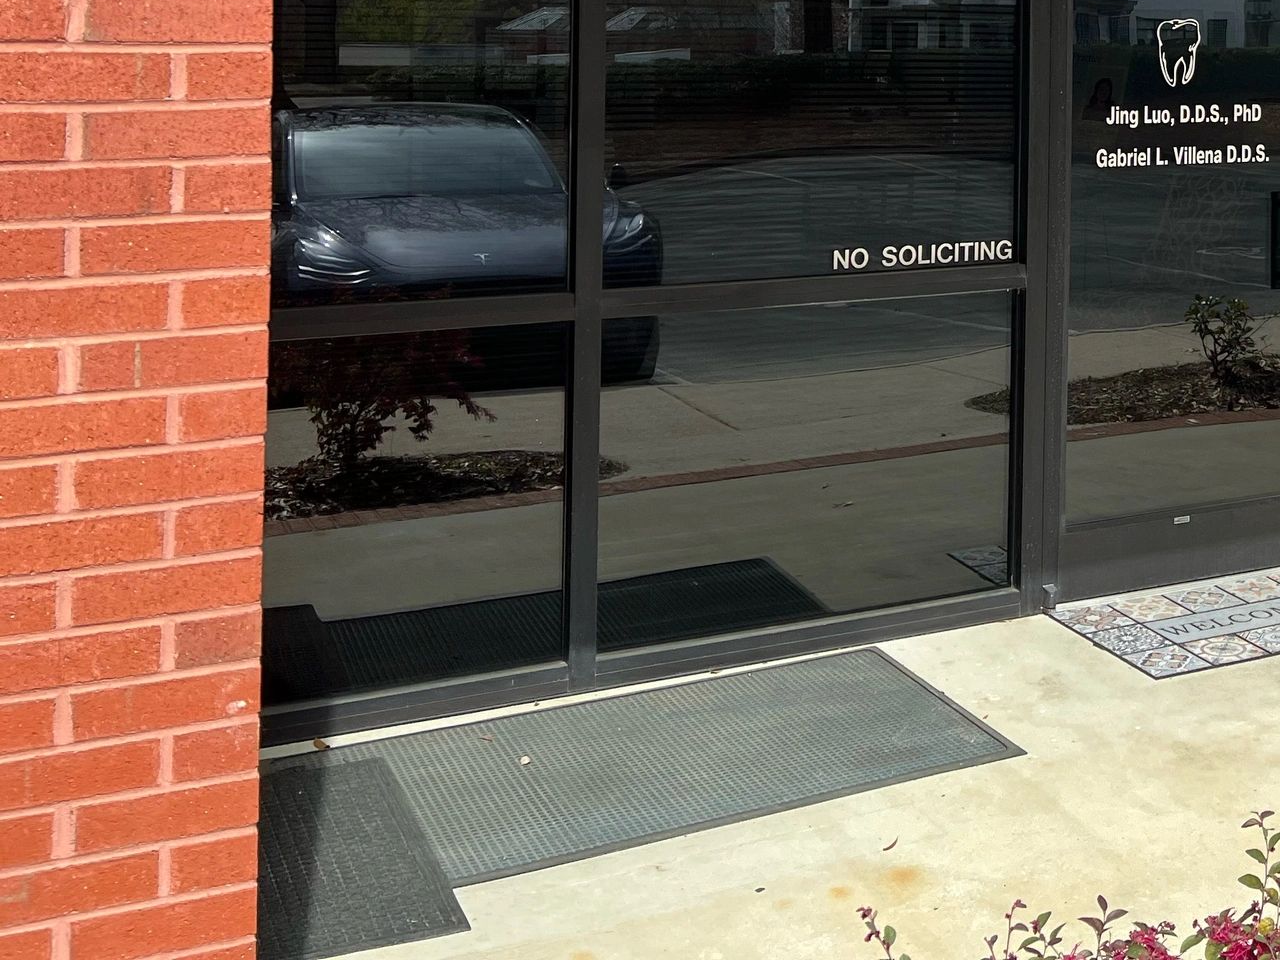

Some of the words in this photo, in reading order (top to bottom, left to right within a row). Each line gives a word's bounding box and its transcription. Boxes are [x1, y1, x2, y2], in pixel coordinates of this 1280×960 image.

[1105, 105, 1139, 129] Jing
[1143, 105, 1175, 127] Luo,
[1179, 103, 1229, 126] D.D.S.,
[1233, 103, 1262, 122] PhD
[1095, 147, 1151, 168] Gabriel
[1155, 147, 1169, 166] L.
[1173, 145, 1223, 165] Villena
[1226, 143, 1270, 164] D.D.S.
[833, 247, 869, 270] NO
[881, 239, 1013, 267] SOLICITING
